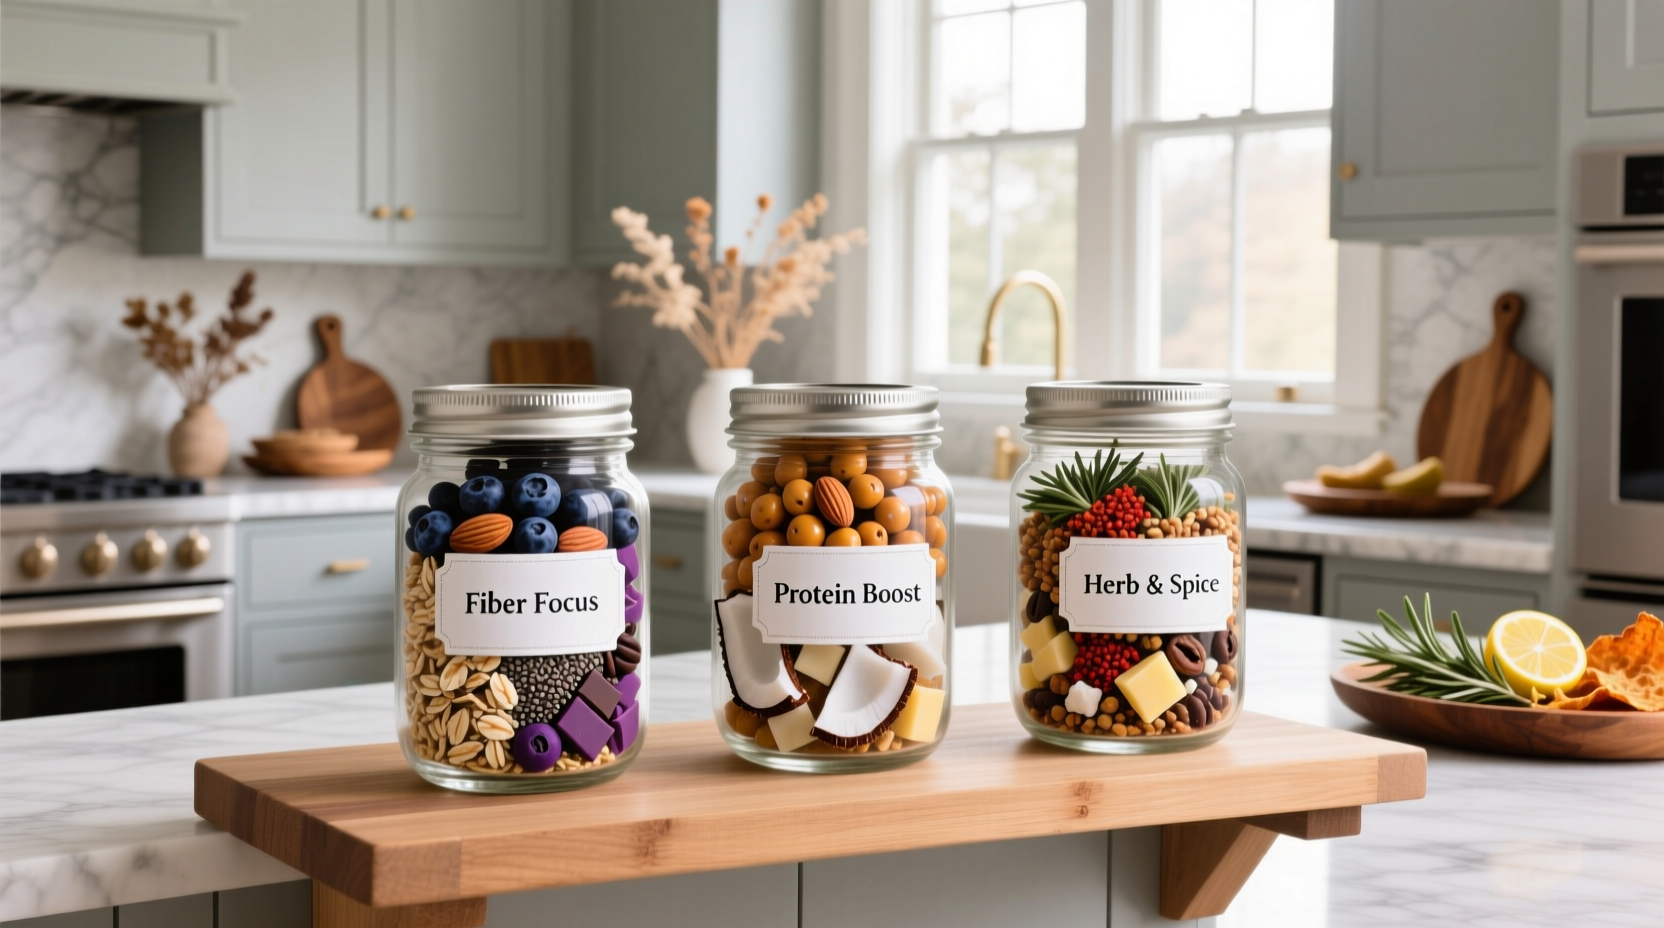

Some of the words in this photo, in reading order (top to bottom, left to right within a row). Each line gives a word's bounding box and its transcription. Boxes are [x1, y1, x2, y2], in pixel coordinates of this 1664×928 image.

[773, 583, 856, 604] Protein
[863, 582, 922, 603] Boost
[1083, 573, 1140, 595] Herb
[1147, 574, 1164, 595] &
[1171, 574, 1219, 600] Spice
[465, 591, 527, 614] Fiber
[534, 592, 598, 613] Focus
